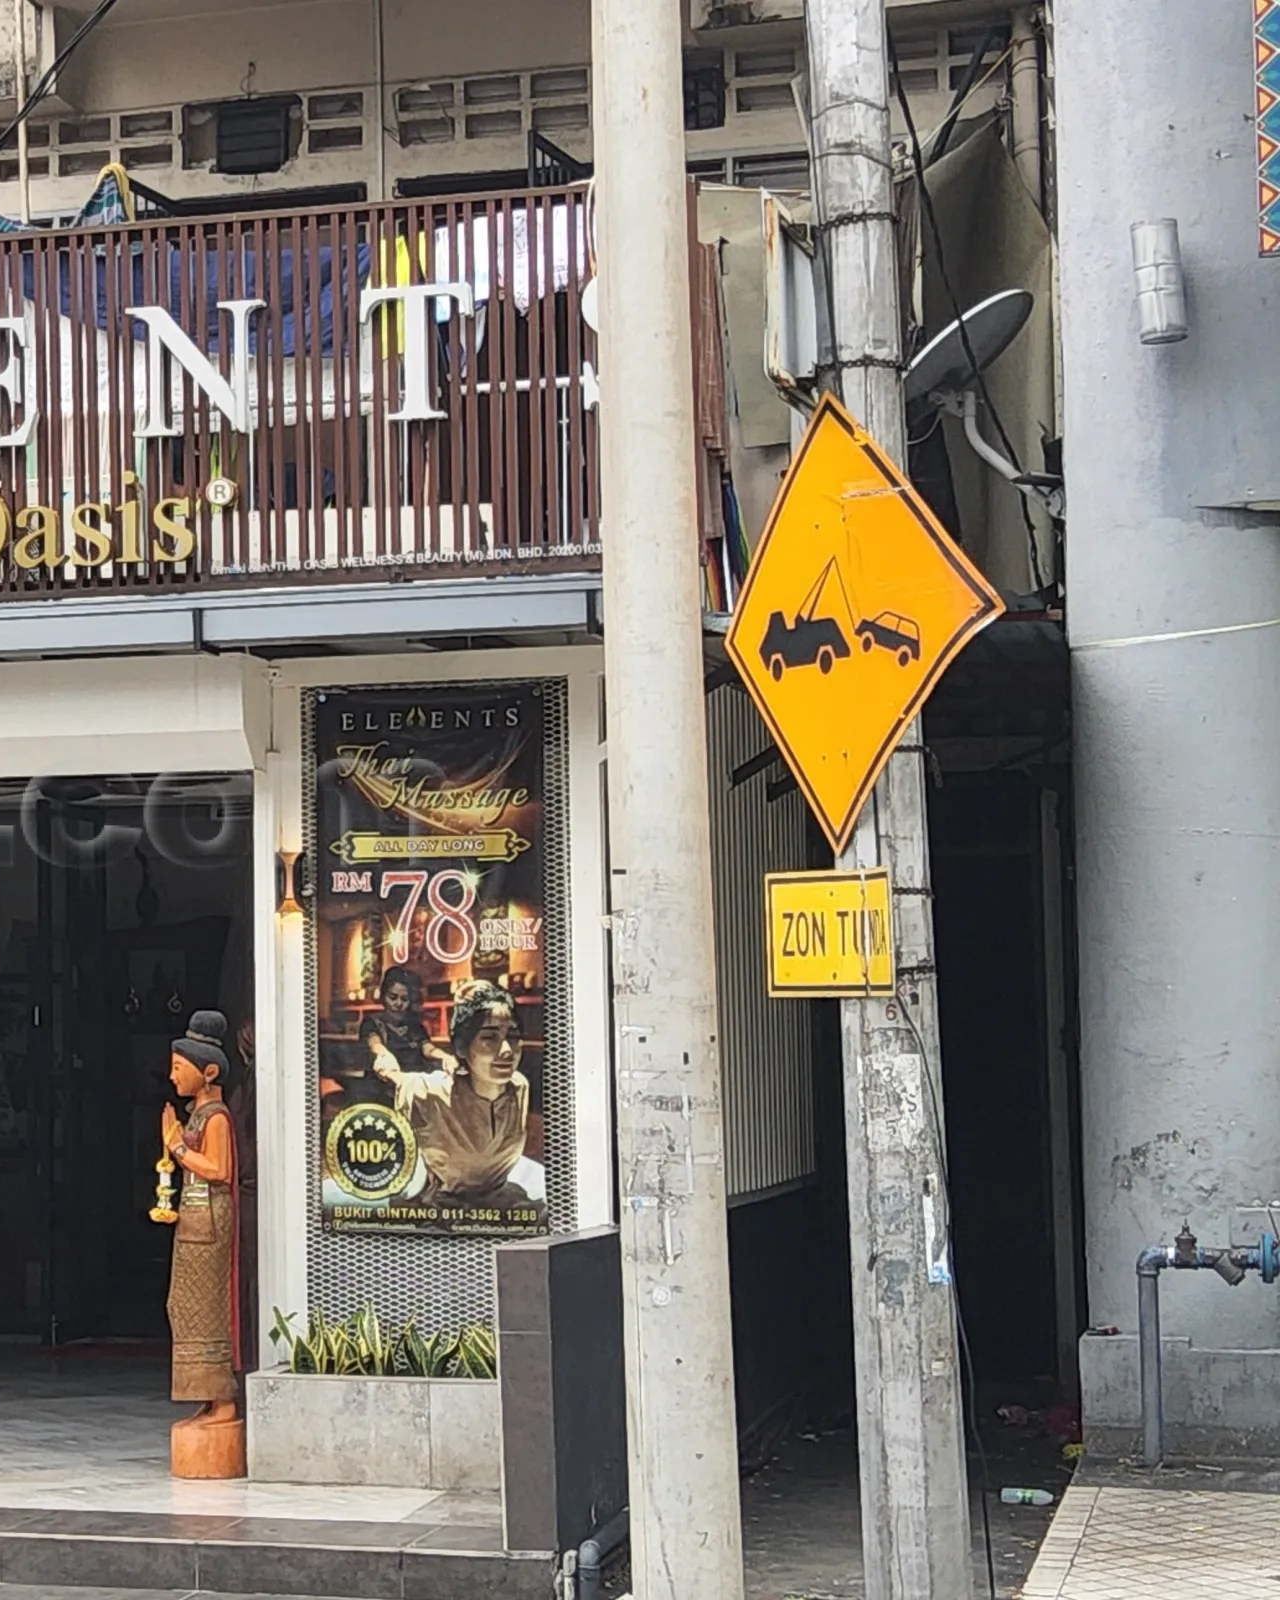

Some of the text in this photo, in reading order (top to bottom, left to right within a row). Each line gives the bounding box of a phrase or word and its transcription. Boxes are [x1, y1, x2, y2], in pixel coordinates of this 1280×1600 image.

[517, 545, 548, 559] BHD.
[336, 740, 415, 778] Thai
[381, 773, 532, 827] Massage
[373, 837, 486, 853] ALL DAY LONG
[331, 869, 478, 964] RM 78
[782, 911, 826, 957] ZON
[346, 1139, 397, 1163] 100%
[334, 1206, 372, 1219] BUKIT
[377, 1207, 438, 1220] BINTANG
